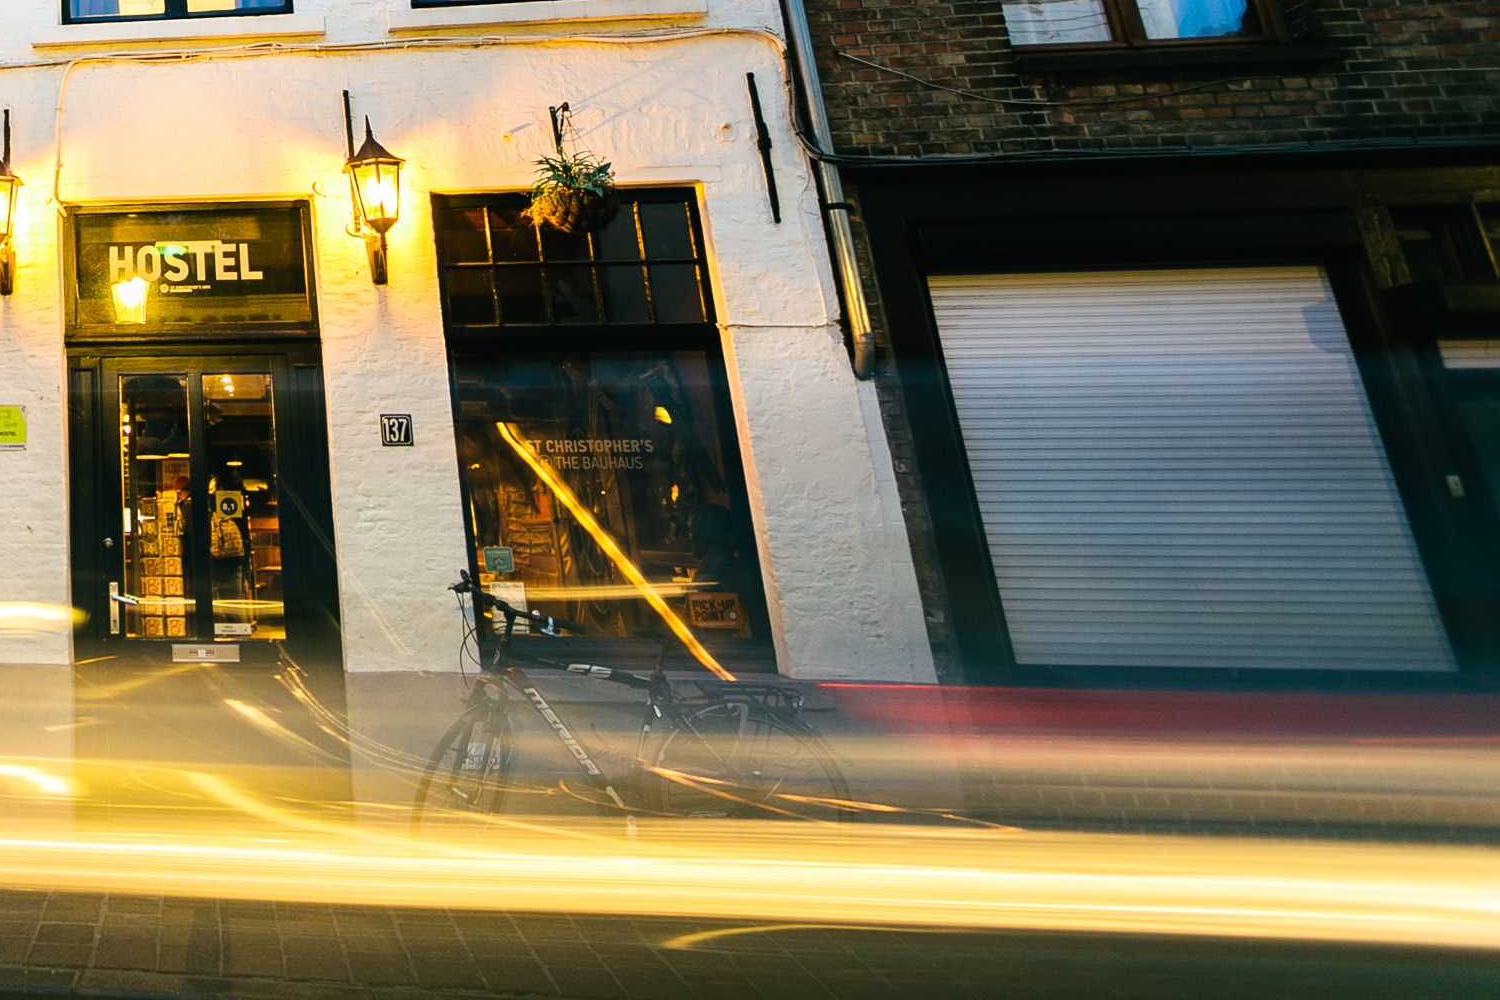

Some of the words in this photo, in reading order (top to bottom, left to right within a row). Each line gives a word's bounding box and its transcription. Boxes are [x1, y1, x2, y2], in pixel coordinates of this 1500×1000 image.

[109, 243, 264, 283] HOSTEL
[383, 418, 407, 442] 137
[525, 440, 541, 453] ST
[545, 440, 654, 453] CHRISTOPHER'S
[555, 456, 580, 469] THE
[582, 456, 643, 470] BAUHAUS
[222, 502, 235, 512] 8,1
[692, 599, 735, 610] PICK-UP
[694, 611, 725, 621] POINT
[524, 687, 600, 776] MERIDA
